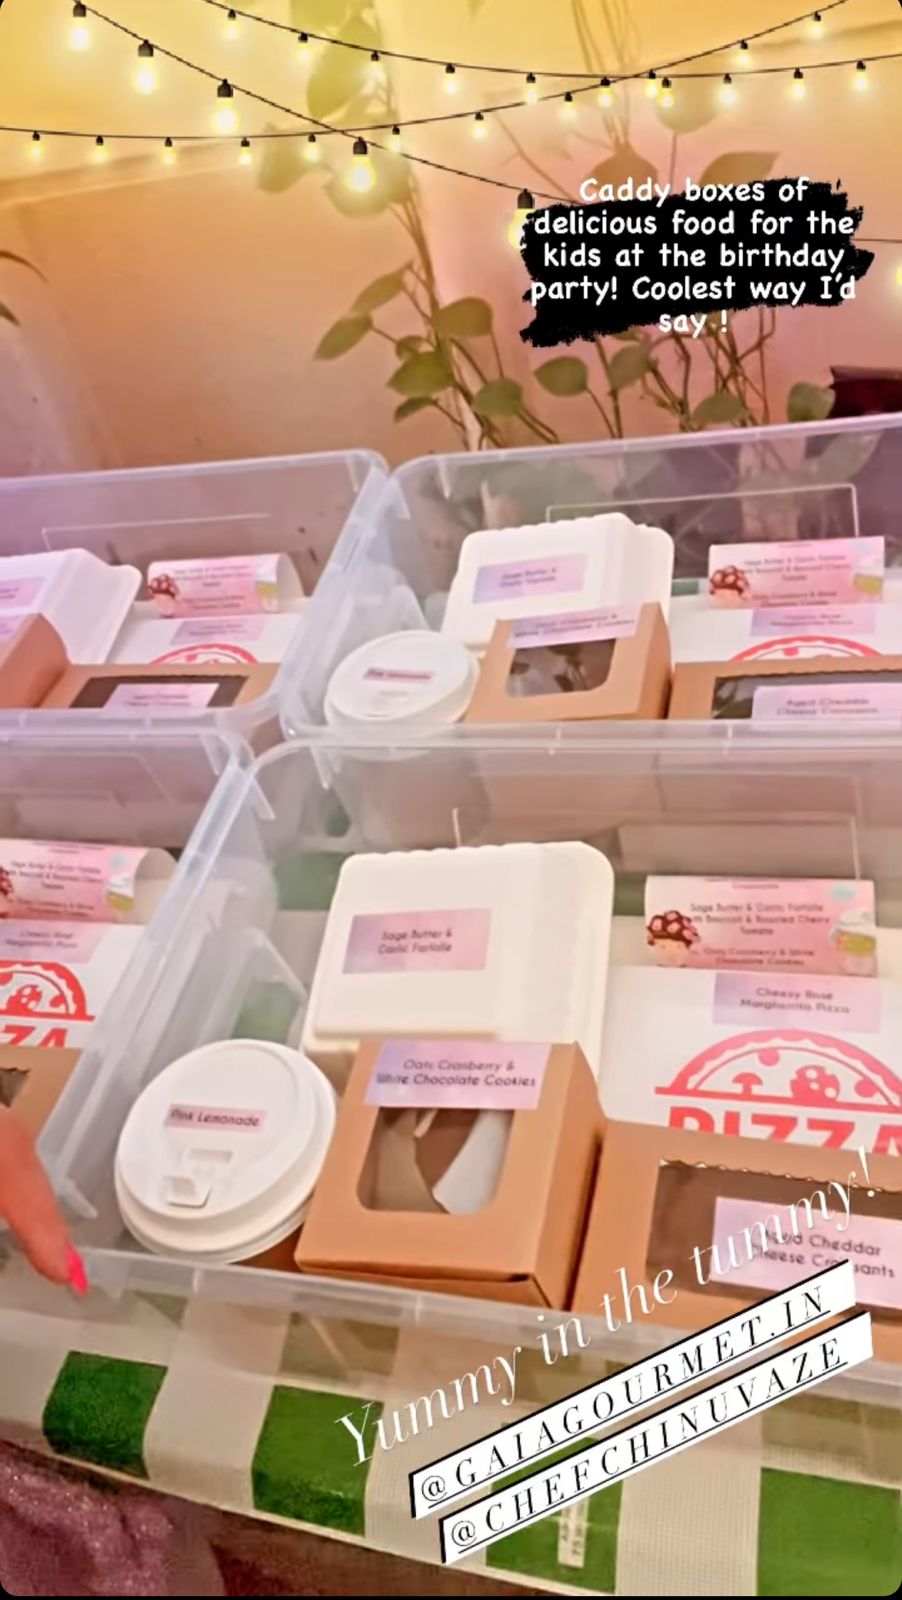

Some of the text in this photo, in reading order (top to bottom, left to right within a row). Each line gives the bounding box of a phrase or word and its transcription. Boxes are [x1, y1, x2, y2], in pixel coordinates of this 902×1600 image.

[438, 1058, 500, 1073] Cranberry
[376, 1072, 536, 1088] White Chocolate Cookies
[197, 1111, 260, 1127] Lemonade
[809, 1233, 882, 1255] Cheddar
